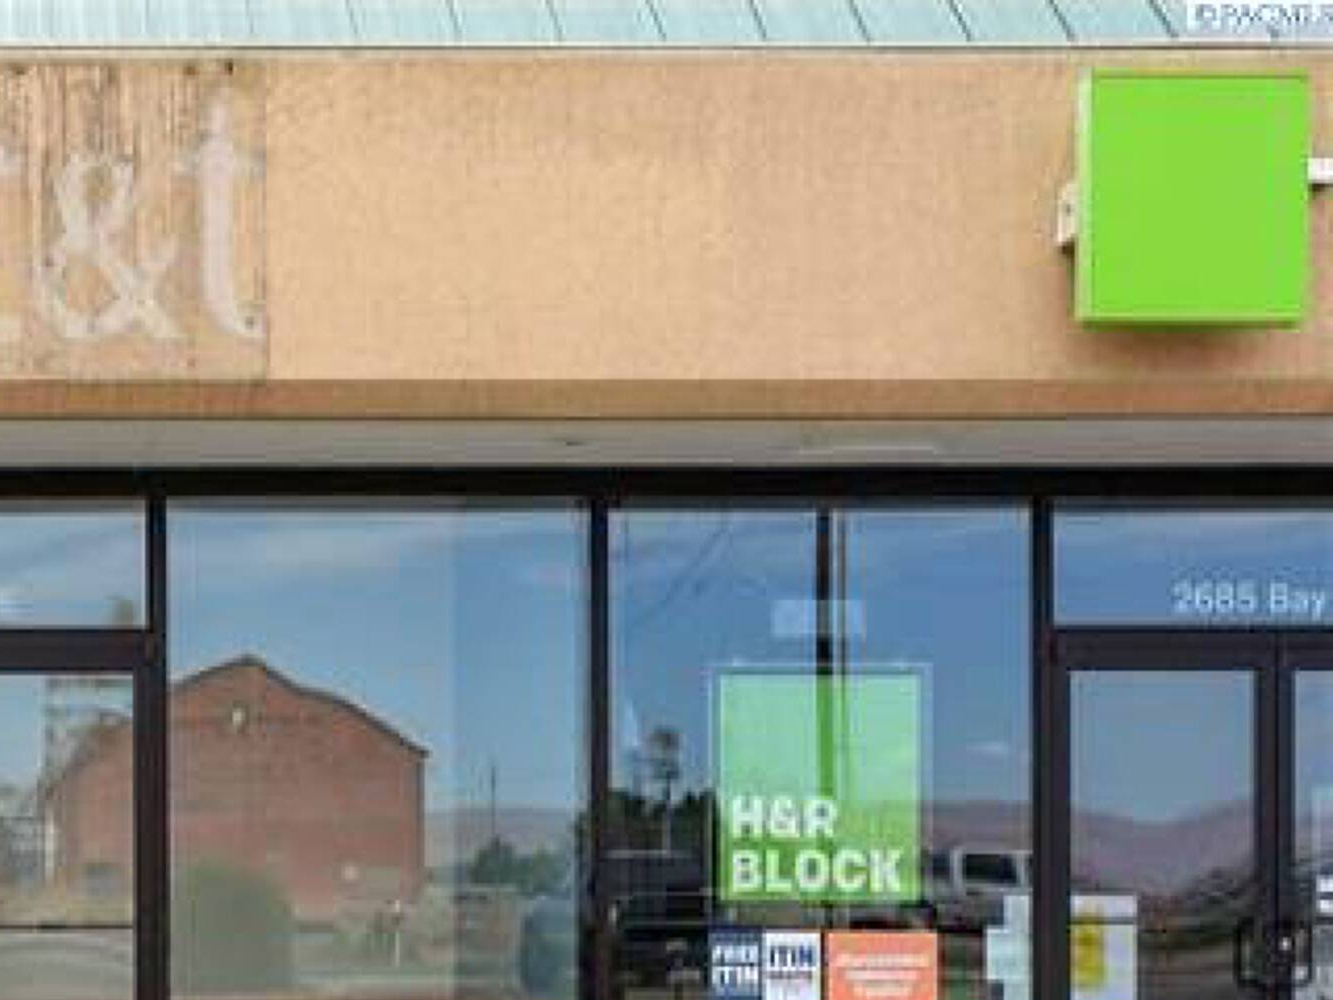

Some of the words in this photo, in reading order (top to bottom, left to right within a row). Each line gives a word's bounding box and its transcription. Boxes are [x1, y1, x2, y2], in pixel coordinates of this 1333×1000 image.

[1173, 580, 1255, 614] 2685
[1270, 580, 1326, 621] Bay
[731, 796, 837, 838] H&R
[731, 851, 902, 892] BLOCK
